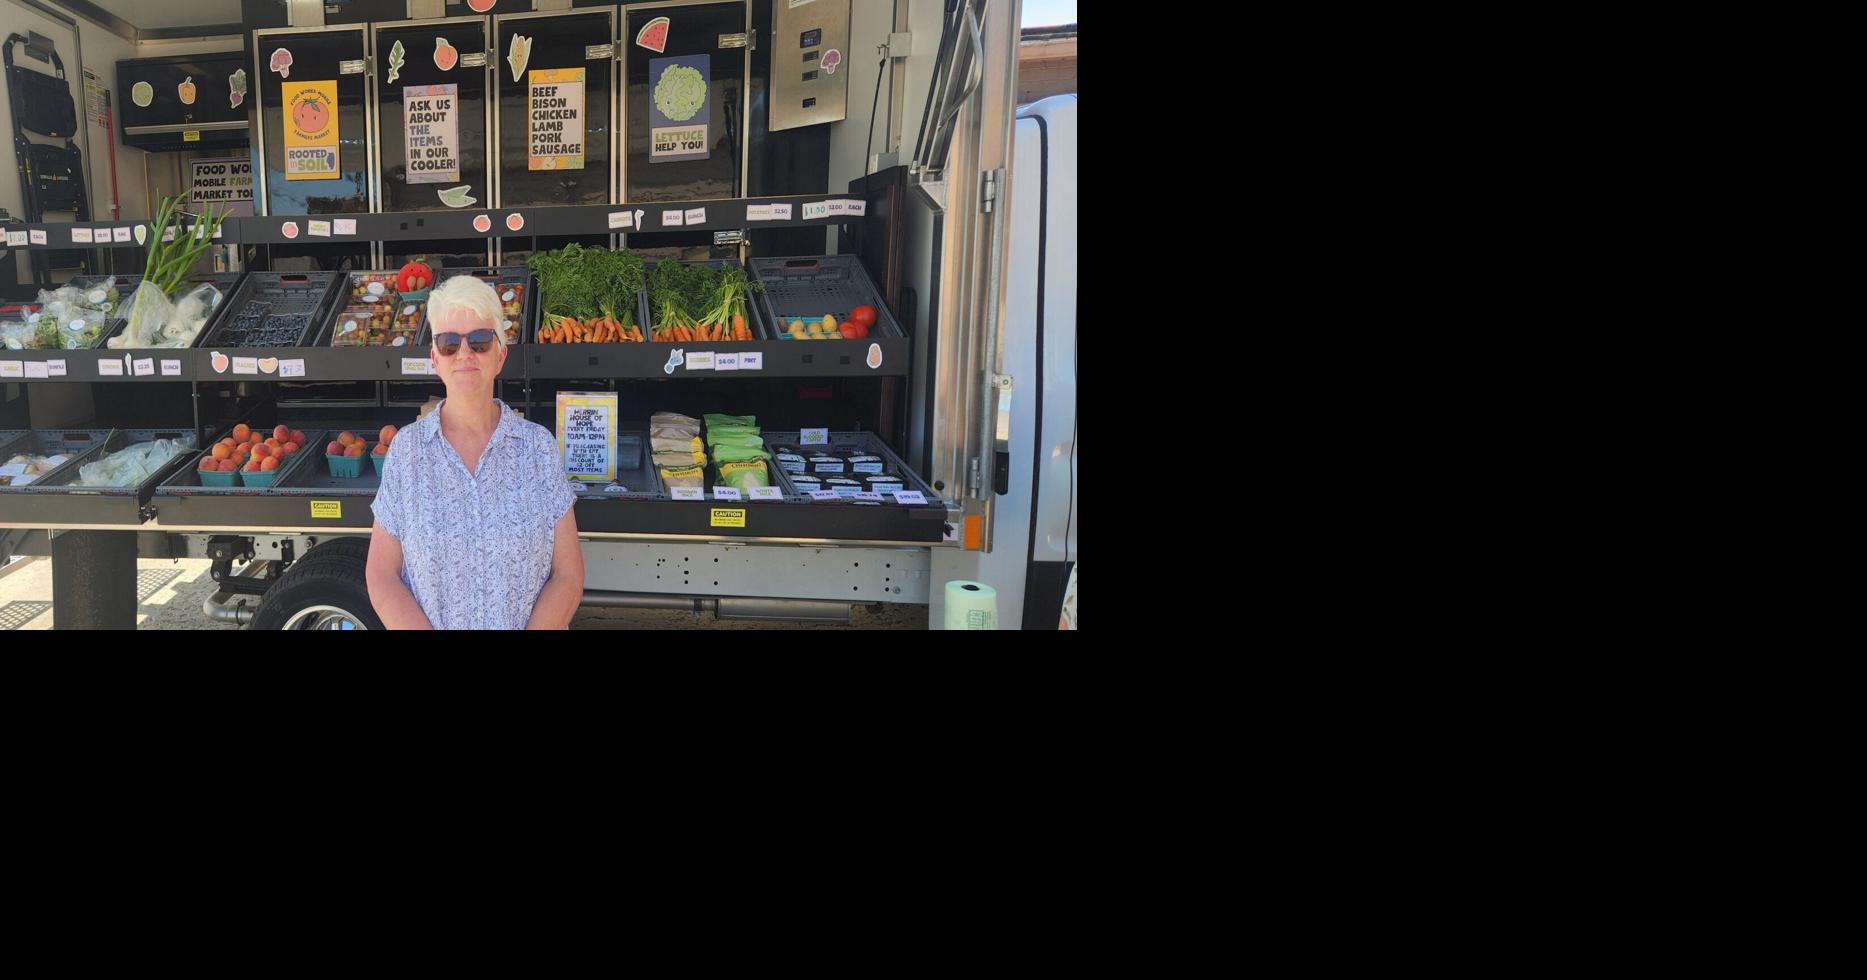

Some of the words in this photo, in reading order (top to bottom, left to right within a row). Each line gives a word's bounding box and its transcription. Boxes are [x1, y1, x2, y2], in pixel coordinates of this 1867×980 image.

[532, 86, 558, 98] BEEF
[409, 100, 431, 111] ASK
[436, 99, 450, 110] US
[532, 98, 567, 109] BISON
[409, 112, 447, 124] ABOUT
[532, 109, 577, 120] CHICKEN
[409, 125, 430, 135] THE
[532, 121, 563, 132] LAMB
[410, 136, 443, 147] ITEMS
[532, 132, 562, 143] PORK
[655, 130, 704, 142] LETTUCE
[532, 143, 581, 155] SAUSAGE
[655, 142, 677, 152] HELP
[681, 140, 704, 150] YOU!
[288, 149, 327, 159] ROOTED
[410, 148, 421, 159] IN
[426, 147, 449, 158] OUR
[196, 164, 226, 176] FOOD
[298, 159, 328, 171] SOIL
[410, 158, 456, 170] COOLER!
[193, 178, 226, 187] MOBILE
[193, 190, 232, 200] MARKET
